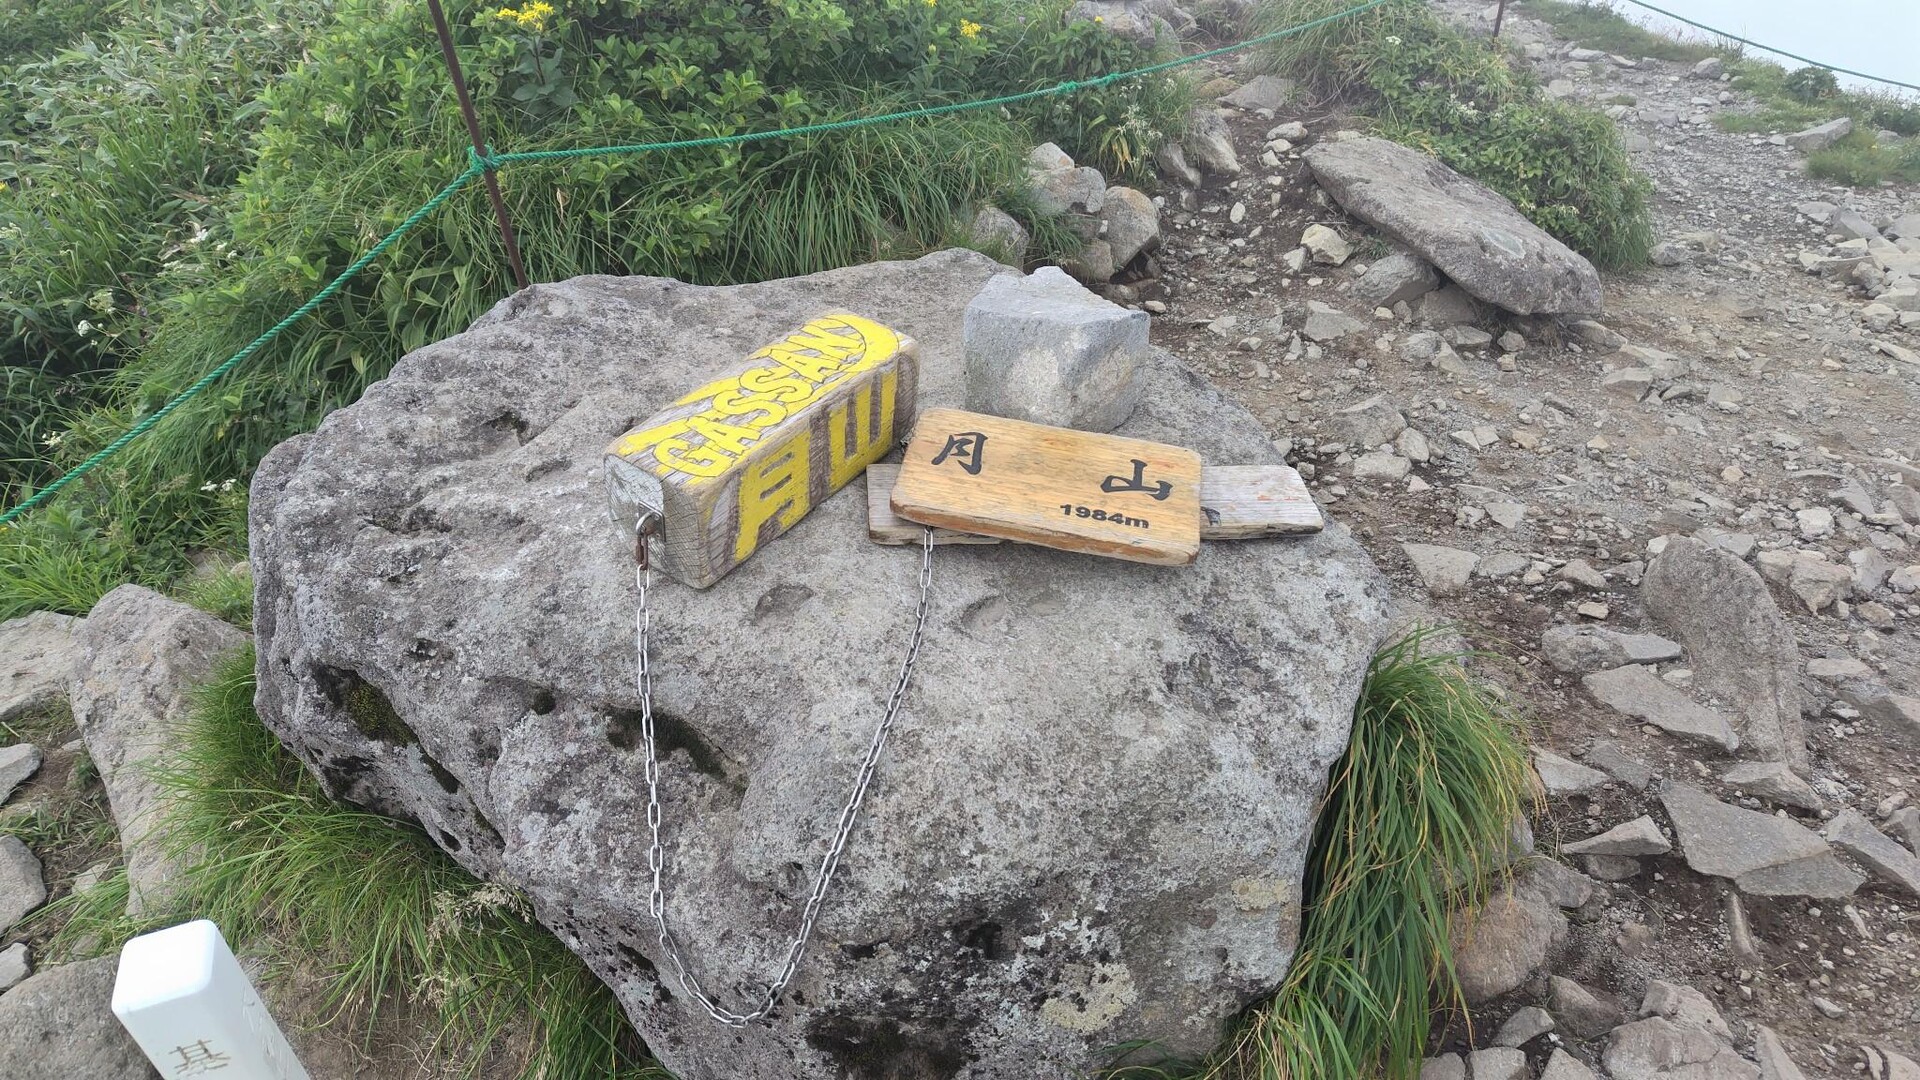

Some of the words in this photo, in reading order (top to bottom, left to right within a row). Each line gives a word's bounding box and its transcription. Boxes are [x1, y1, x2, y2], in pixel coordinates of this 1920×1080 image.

[652, 324, 863, 478] GASSAN
[735, 370, 898, 563] 月山
[1059, 503, 1149, 529] 1984m
